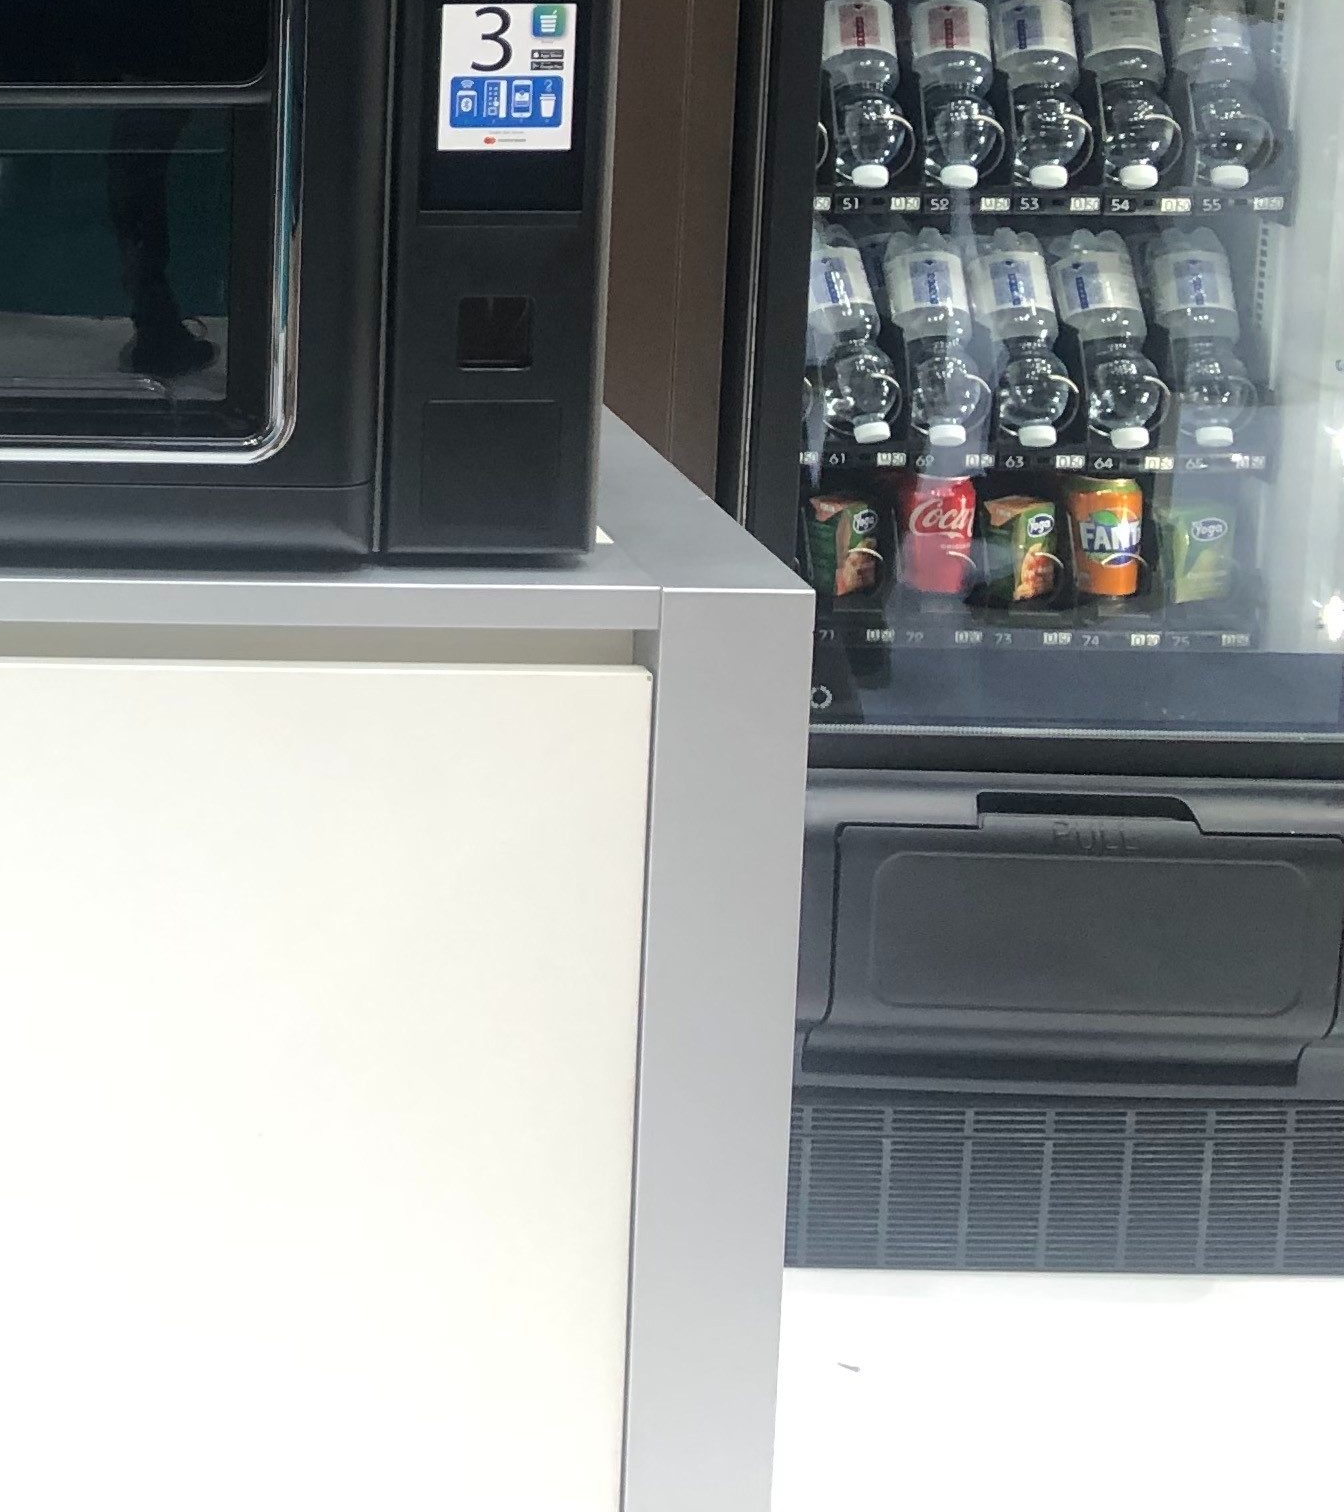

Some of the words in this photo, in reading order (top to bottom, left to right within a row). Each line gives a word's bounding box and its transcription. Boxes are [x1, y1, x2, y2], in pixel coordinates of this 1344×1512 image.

[470, 6, 513, 72] 3
[842, 196, 860, 210] 51
[930, 197, 950, 211] 52
[1019, 197, 1039, 210] 53
[1111, 199, 1130, 212] 54
[1202, 198, 1222, 211] 55
[828, 452, 846, 464] 61
[1005, 455, 1024, 468] 63
[1093, 457, 1114, 470] 64
[1081, 636, 1100, 648] 74
[1051, 821, 1140, 852] PULL
